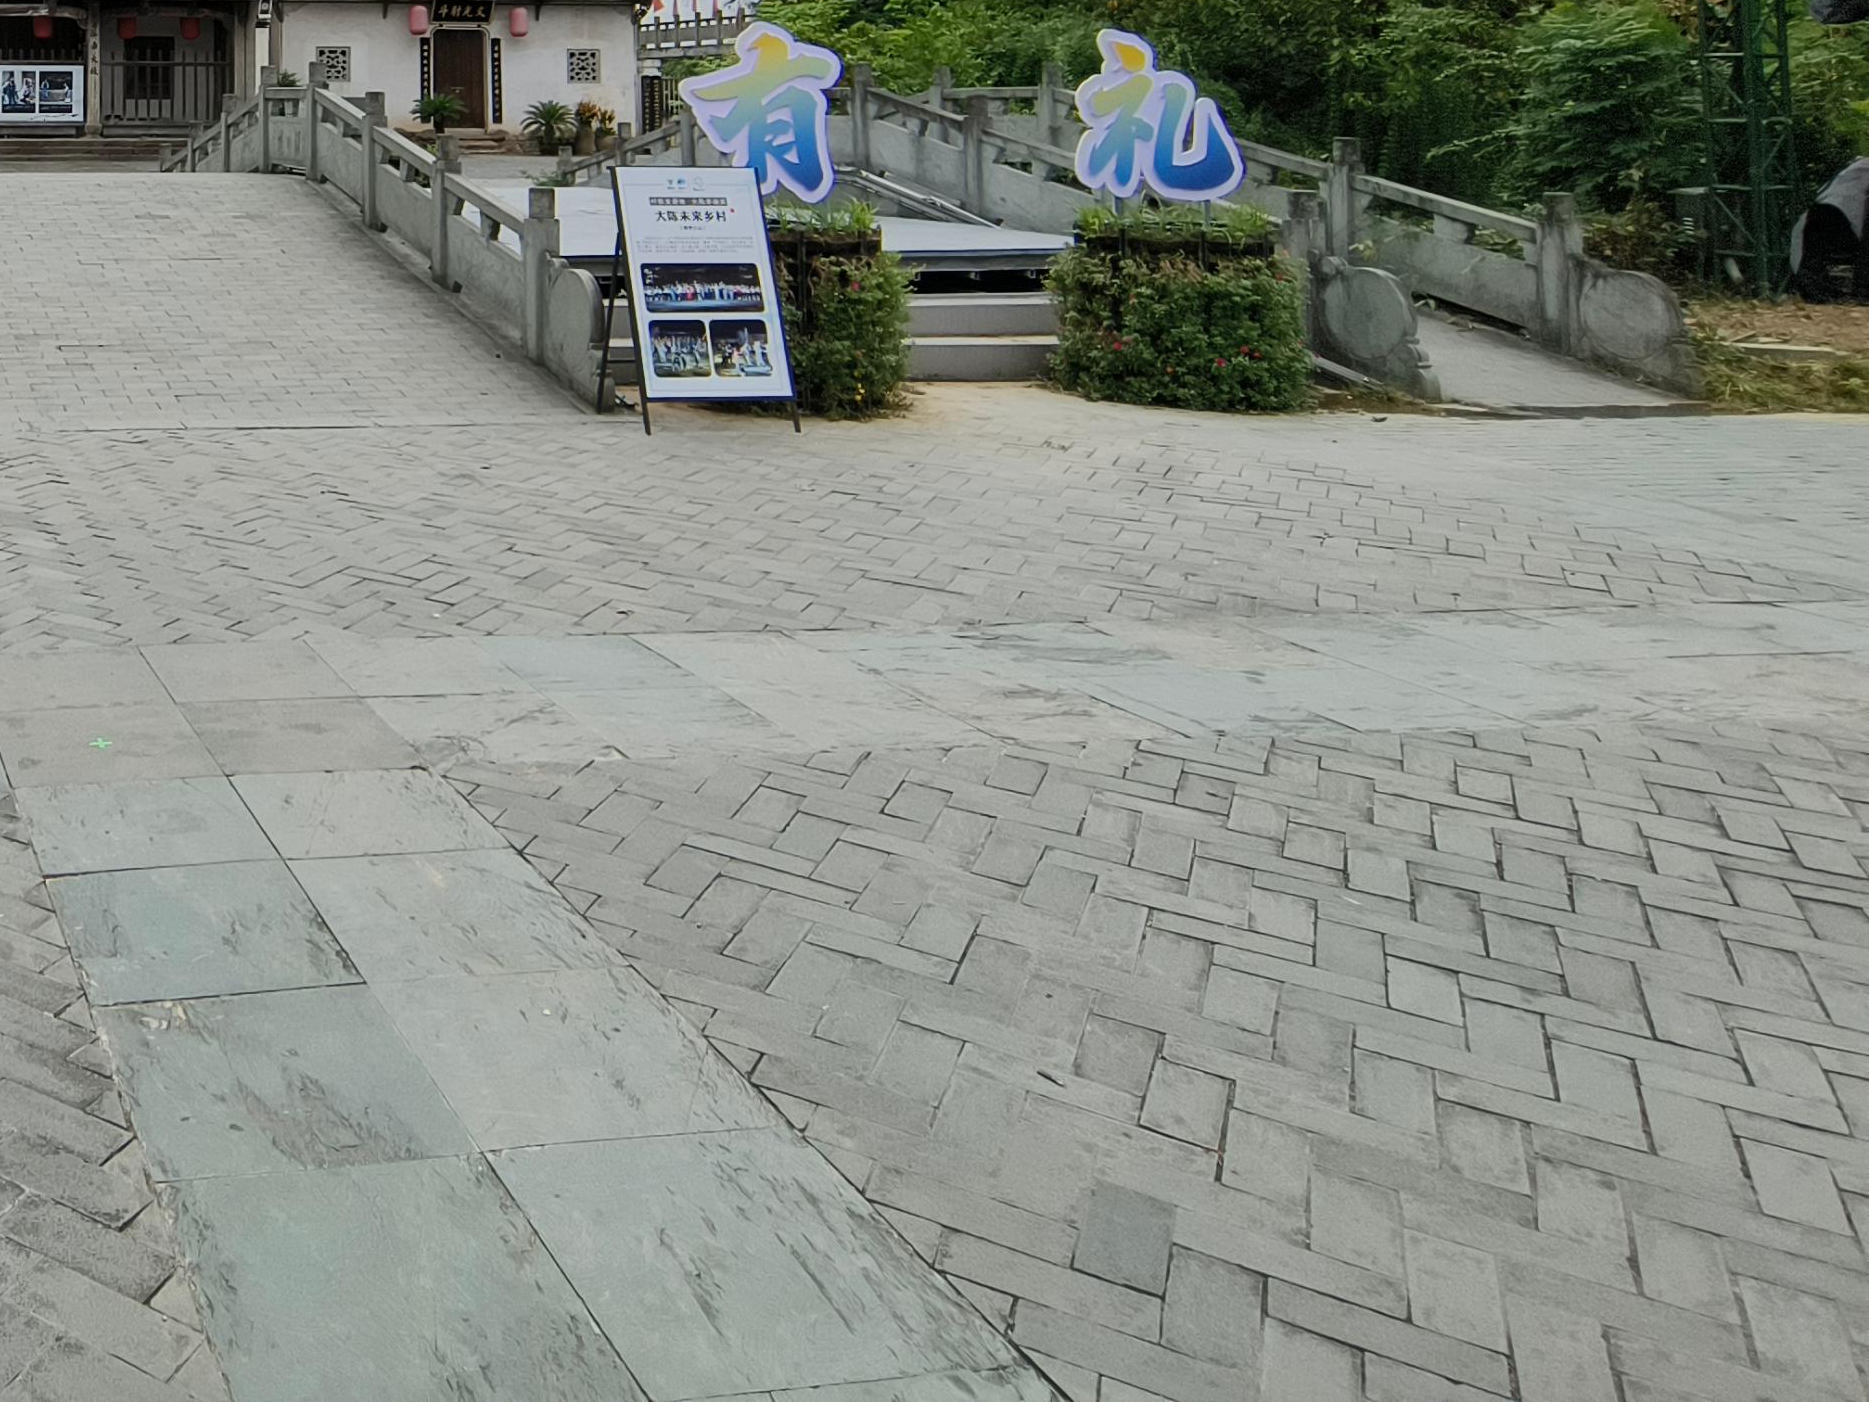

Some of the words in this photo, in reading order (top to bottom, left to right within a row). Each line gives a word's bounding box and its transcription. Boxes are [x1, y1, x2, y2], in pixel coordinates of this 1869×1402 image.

[688, 31, 834, 193] 有
[1086, 39, 1236, 192] 礼
[655, 210, 727, 223] 大陈未来乡村
